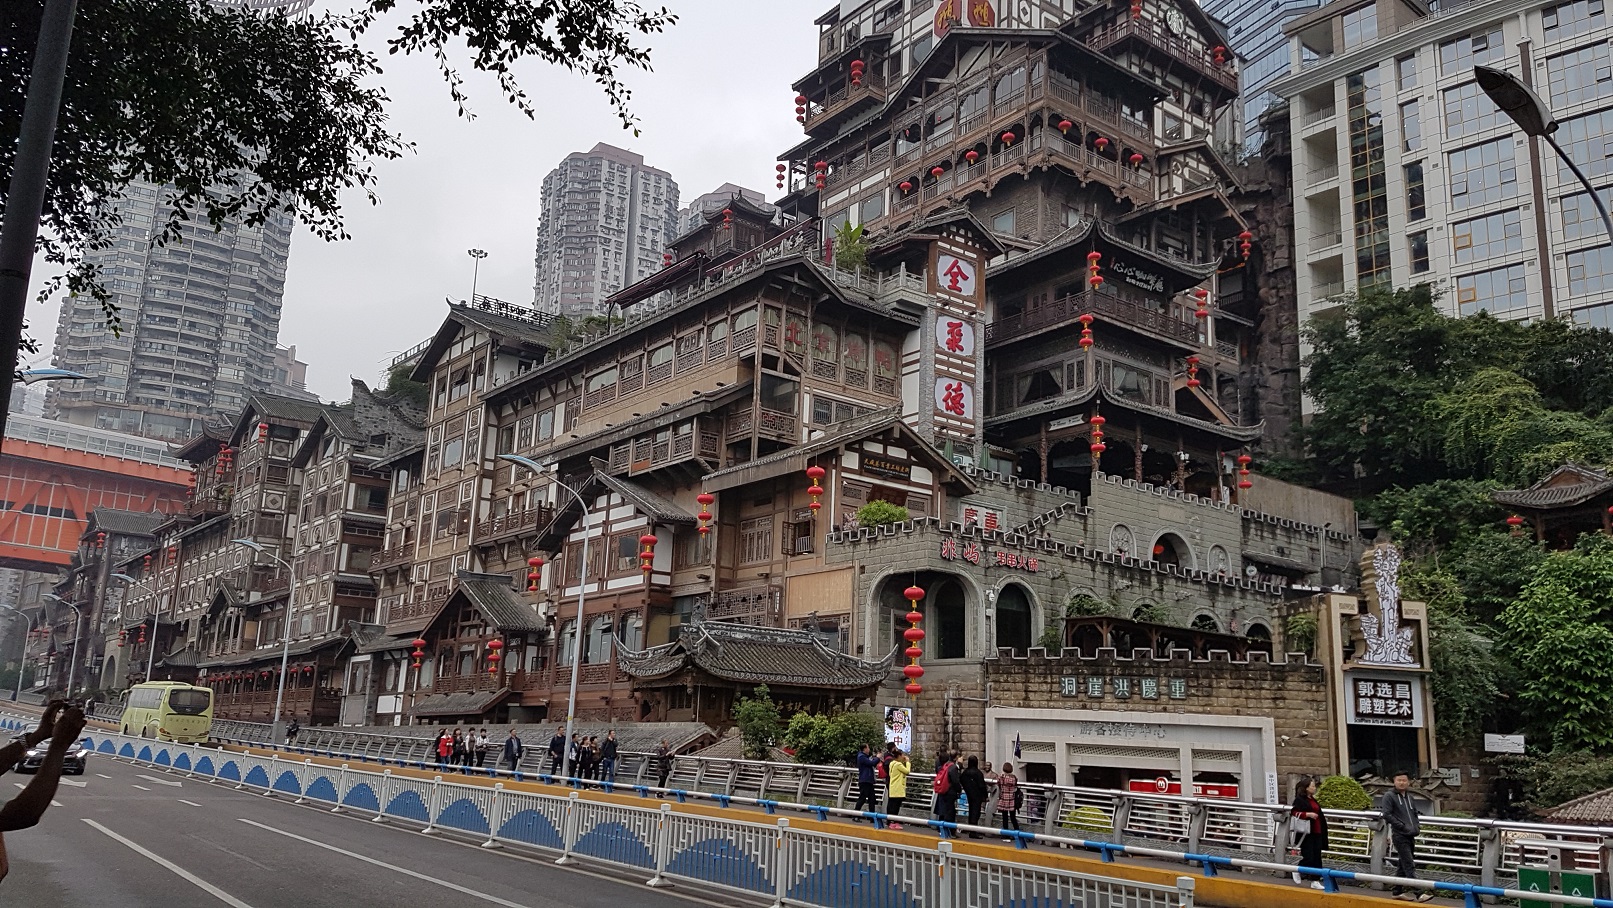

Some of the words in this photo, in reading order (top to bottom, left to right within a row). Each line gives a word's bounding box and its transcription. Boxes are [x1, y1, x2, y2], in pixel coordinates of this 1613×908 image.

[942, 259, 970, 416] 全聚德
[996, 551, 1039, 573] 串串火锅
[1358, 681, 1411, 699] 郭选昌
[1359, 698, 1412, 716] 雕塑艺术
[1080, 721, 1167, 739] 游客接待中心
